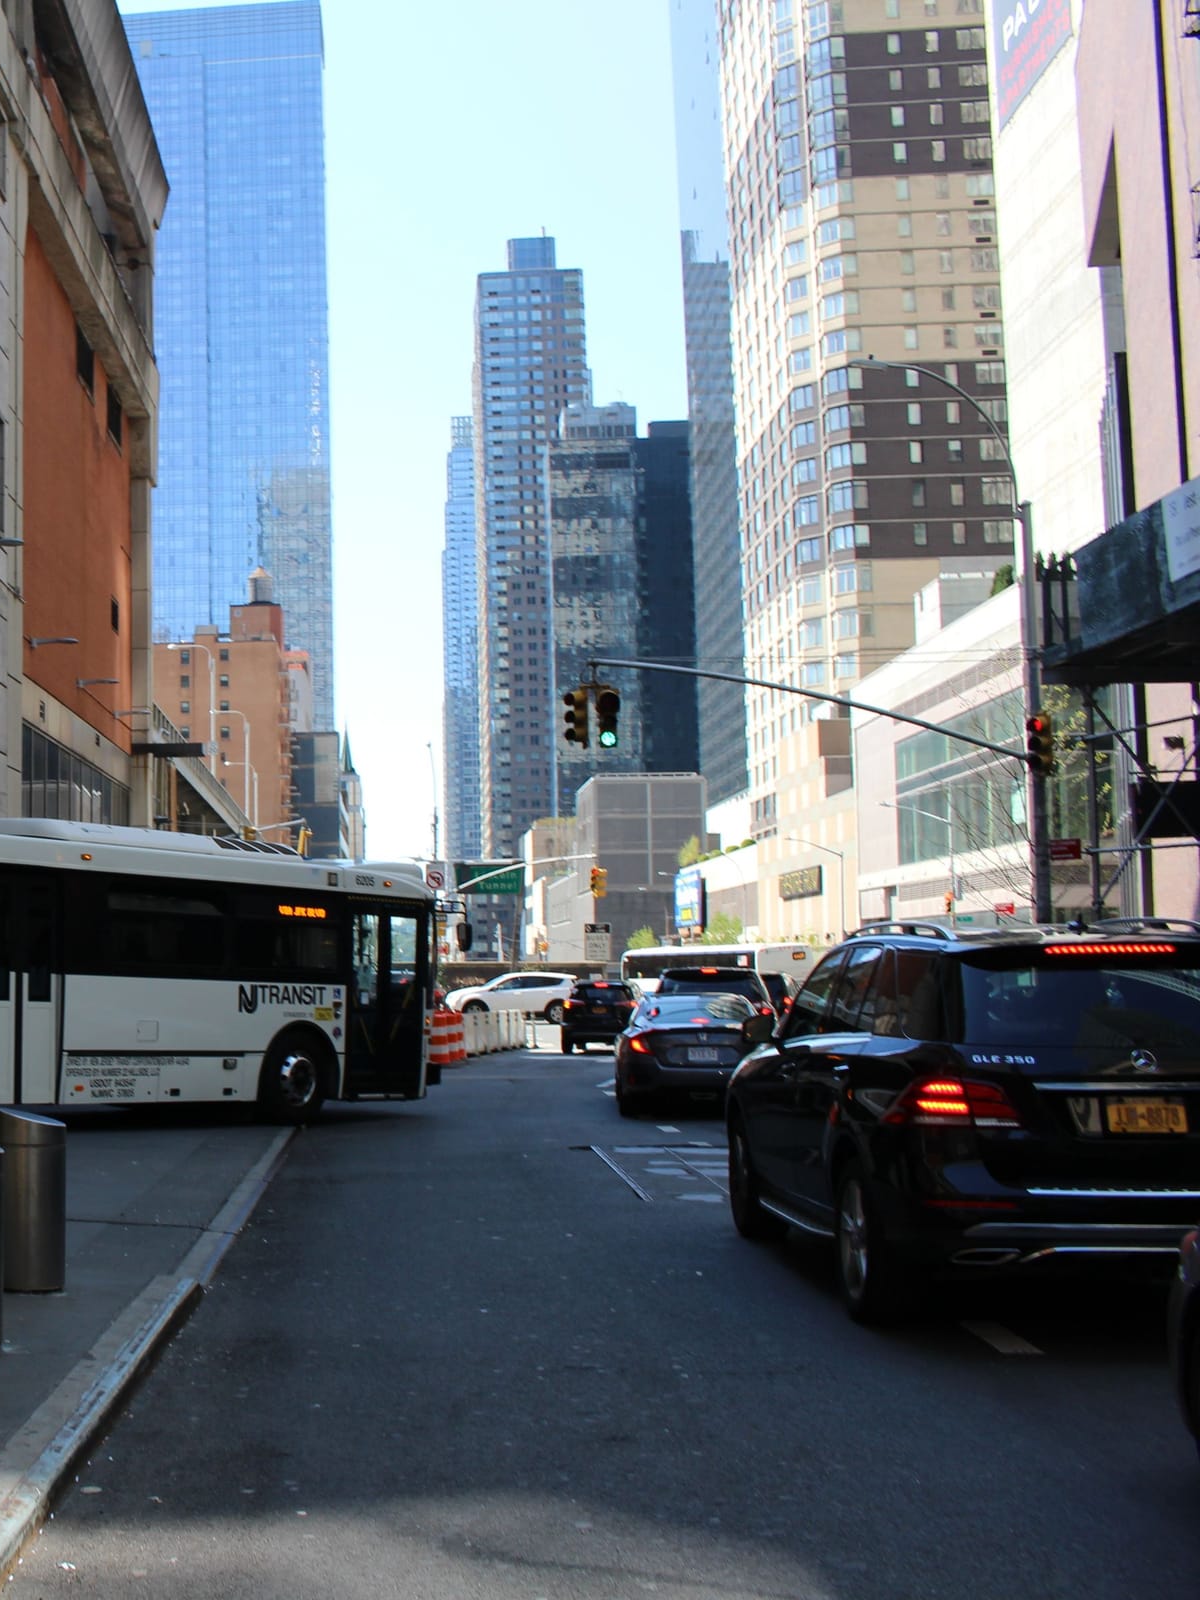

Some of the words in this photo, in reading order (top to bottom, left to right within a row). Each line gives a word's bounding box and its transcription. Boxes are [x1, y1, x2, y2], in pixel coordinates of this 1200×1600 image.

[1002, 0, 1039, 52] PA
[479, 881, 517, 890] Tunnel
[259, 985, 326, 1005] TRANSIT
[972, 1054, 1001, 1064] GLE
[1004, 1055, 1035, 1064] 350
[90, 1078, 113, 1087] USDOT
